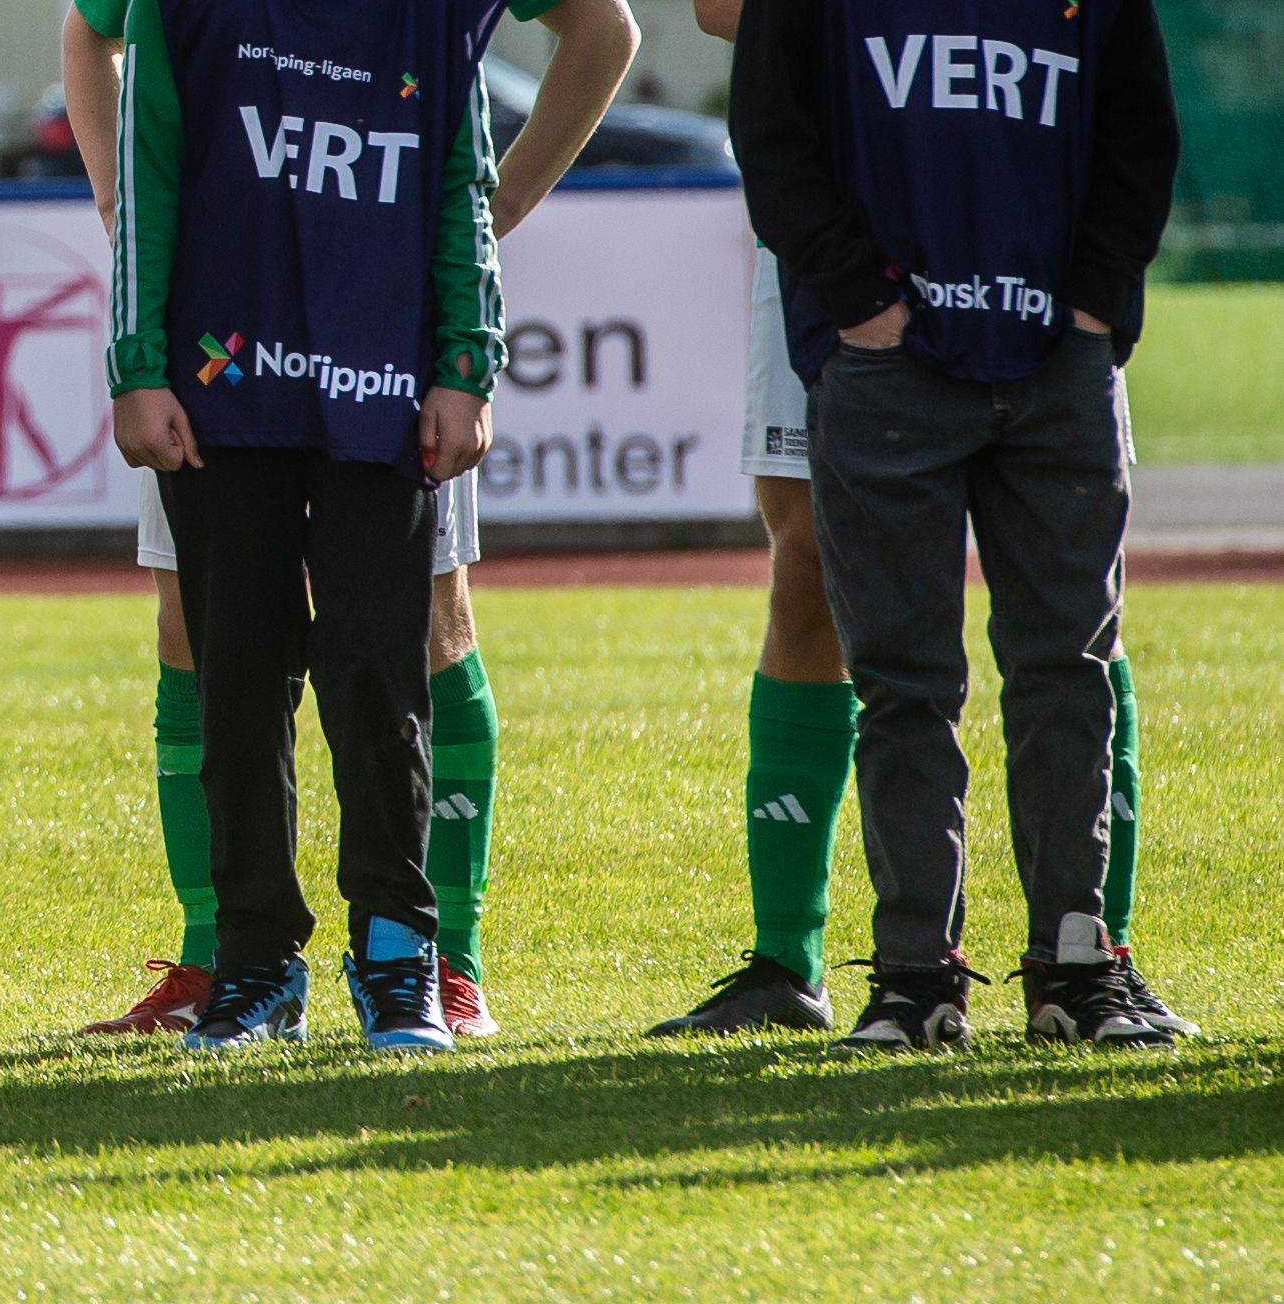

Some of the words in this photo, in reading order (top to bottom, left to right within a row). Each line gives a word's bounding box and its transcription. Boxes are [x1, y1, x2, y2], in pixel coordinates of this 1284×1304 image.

[864, 34, 1080, 127] VERT
[254, 342, 322, 378] Nor
[319, 356, 420, 410] ippin
[505, 316, 647, 392] en
[483, 424, 701, 497] enter
